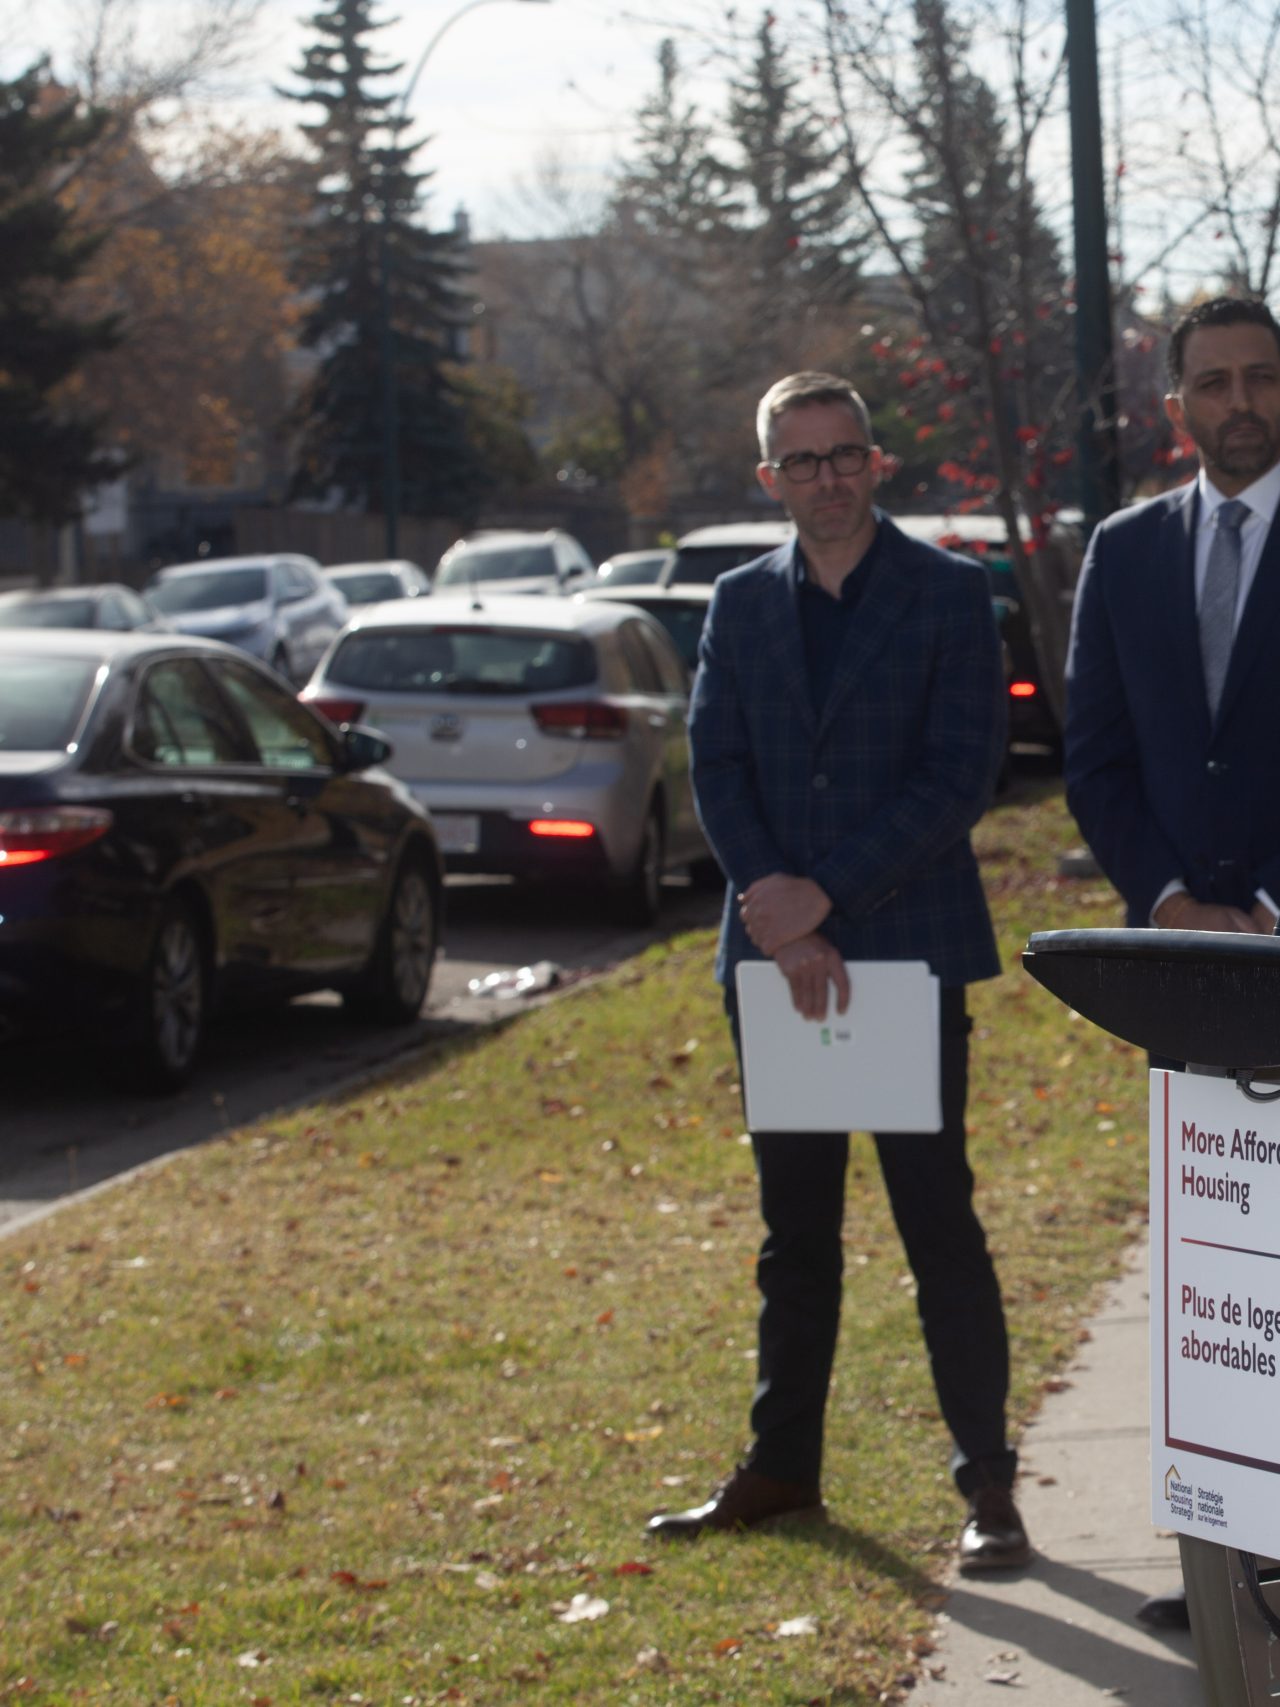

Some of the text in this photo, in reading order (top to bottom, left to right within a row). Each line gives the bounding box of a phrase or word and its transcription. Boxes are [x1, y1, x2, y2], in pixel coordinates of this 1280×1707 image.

[1181, 1120, 1225, 1157] More
[1181, 1164, 1251, 1215] Housing
[1181, 1284, 1216, 1321] Plus
[1221, 1293, 1242, 1326] de
[1181, 1329, 1277, 1378] abordables
[1170, 1480, 1193, 1495] National
[1197, 1487, 1224, 1506] Stratégie
[1170, 1491, 1193, 1510] Housing
[1197, 1502, 1225, 1518] nationale
[1170, 1503, 1194, 1521] Strategy
